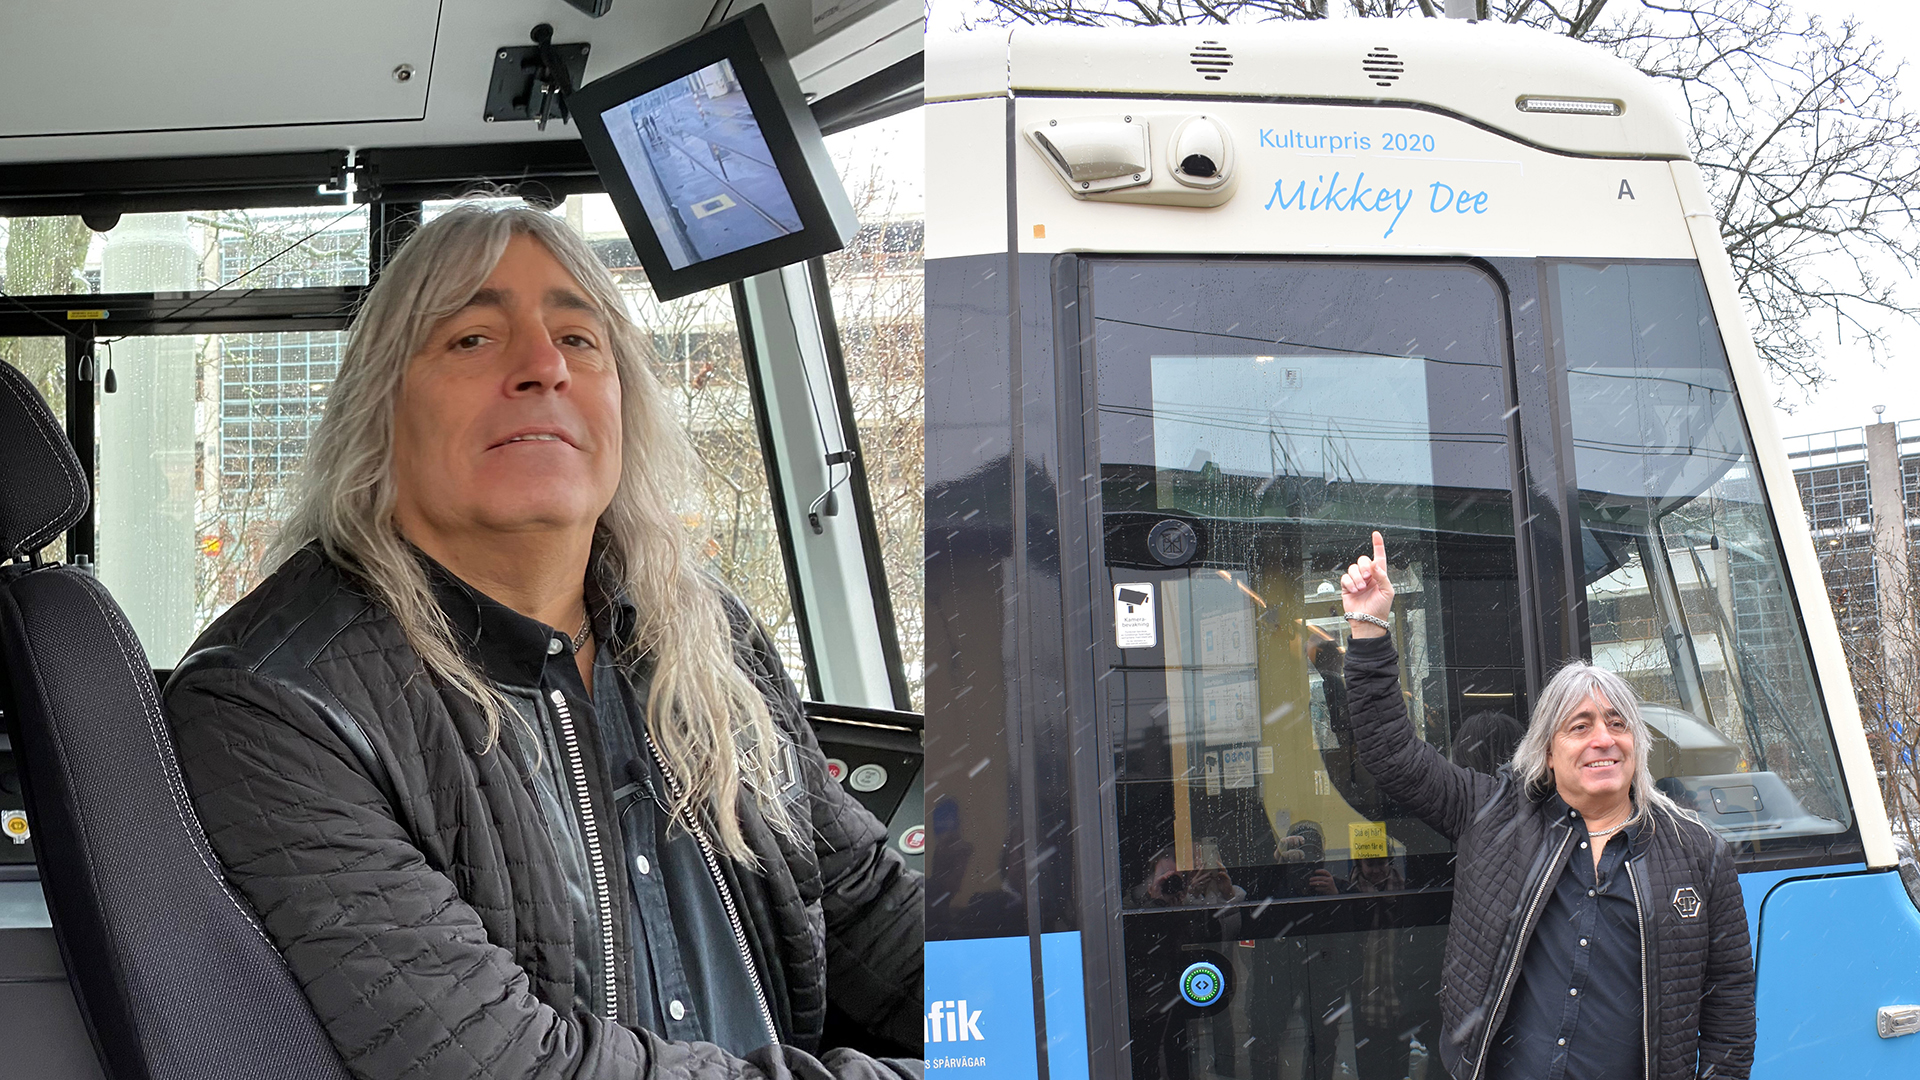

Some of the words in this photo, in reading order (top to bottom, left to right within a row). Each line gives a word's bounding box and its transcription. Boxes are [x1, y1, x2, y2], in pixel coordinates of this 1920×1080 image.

[1260, 128, 1371, 153] Kulturpris
[1382, 132, 1435, 152] 2020
[1617, 179, 1635, 200] A
[1264, 171, 1413, 239] Mikkey
[1429, 181, 1489, 215] Dee
[933, 1055, 986, 1069] SPÅRVÄGAR
